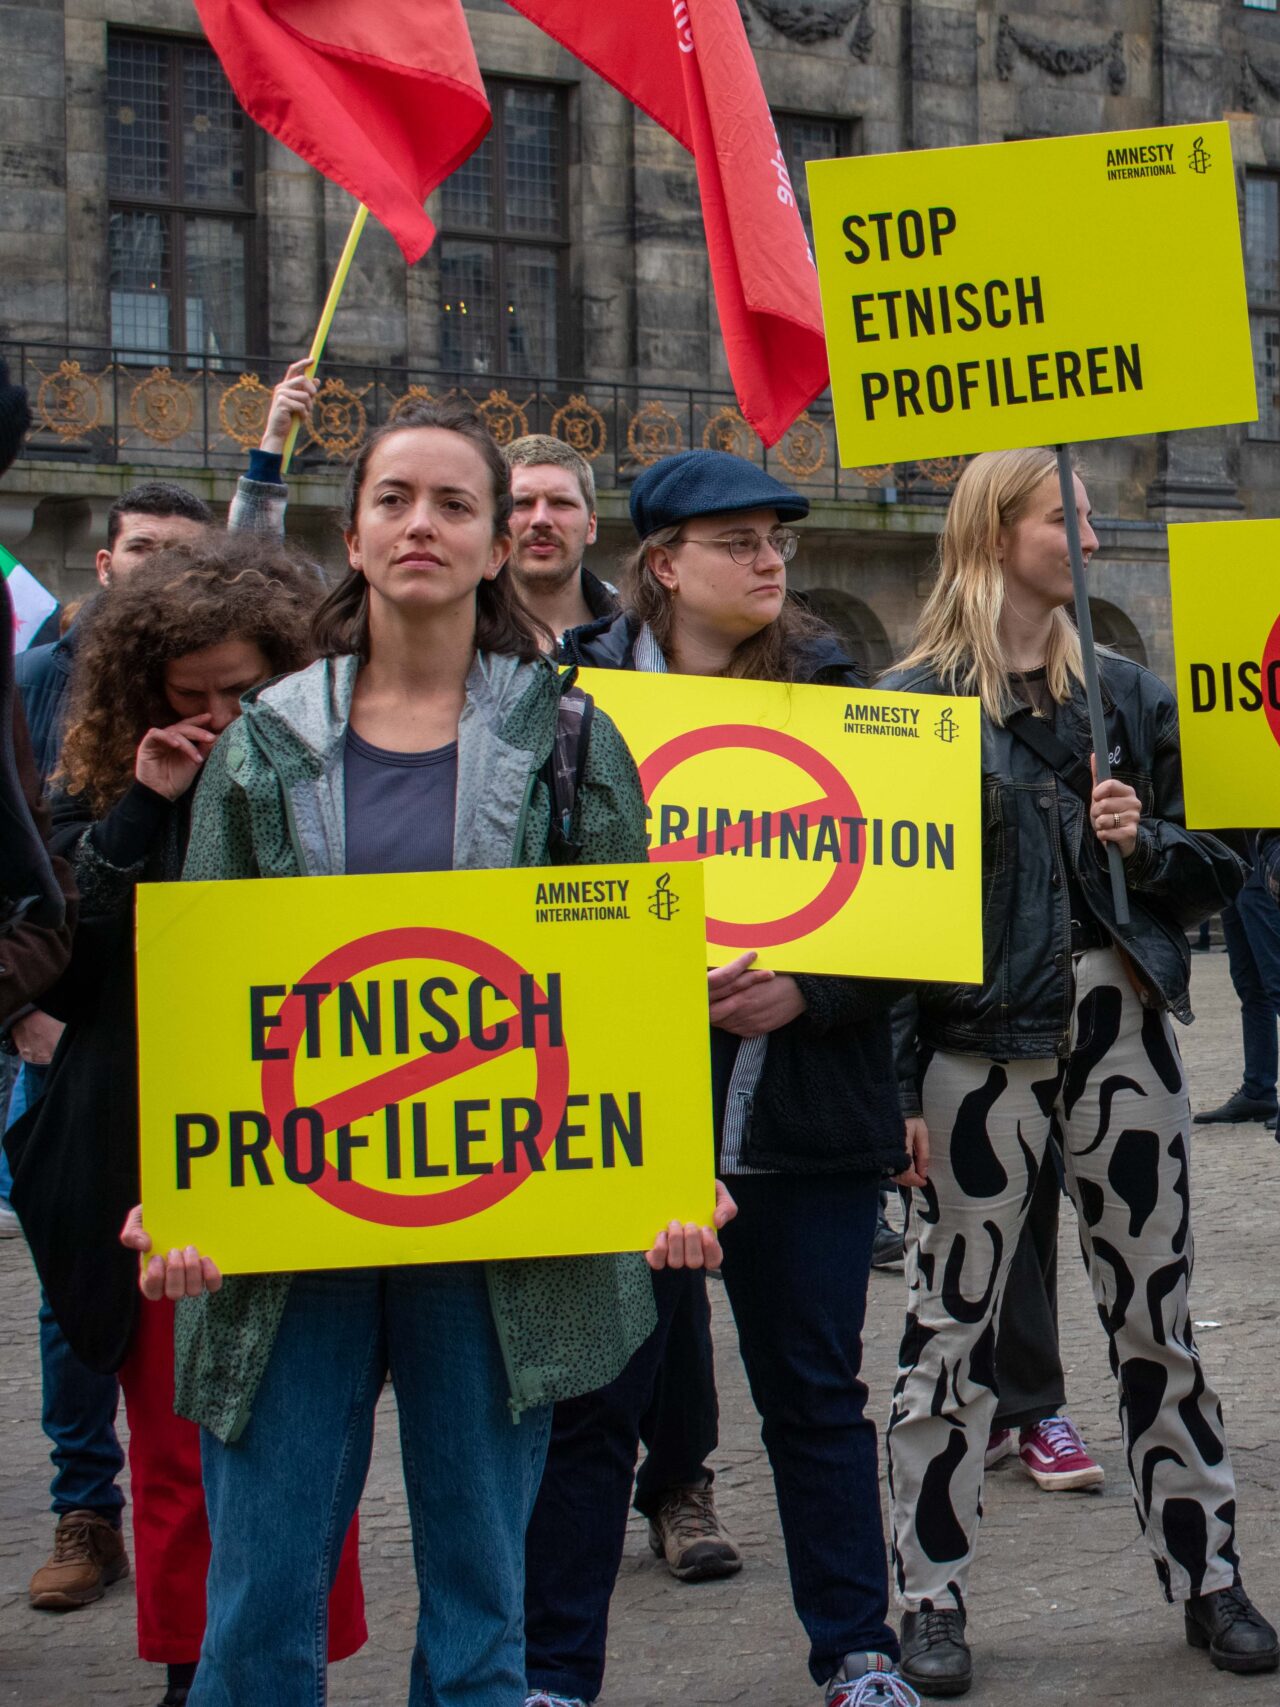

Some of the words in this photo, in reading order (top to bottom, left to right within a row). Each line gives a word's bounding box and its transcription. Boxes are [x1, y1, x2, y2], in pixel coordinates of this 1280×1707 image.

[1106, 143, 1174, 167] AMNESTY
[1106, 164, 1176, 181] INTERNATIONAL
[841, 206, 957, 265] STOP
[851, 275, 1045, 344] ETNISCH
[860, 343, 1144, 421] PROFILEREN
[844, 703, 920, 725] AMNESTY
[844, 723, 920, 739] INTERNATIONAL
[645, 804, 954, 870] RIMINATION
[535, 879, 629, 905] AMNESTY
[536, 906, 631, 923] INTERNATIONAL
[249, 972, 563, 1062] ETNISCH
[174, 1091, 645, 1191] PROFILEREN
